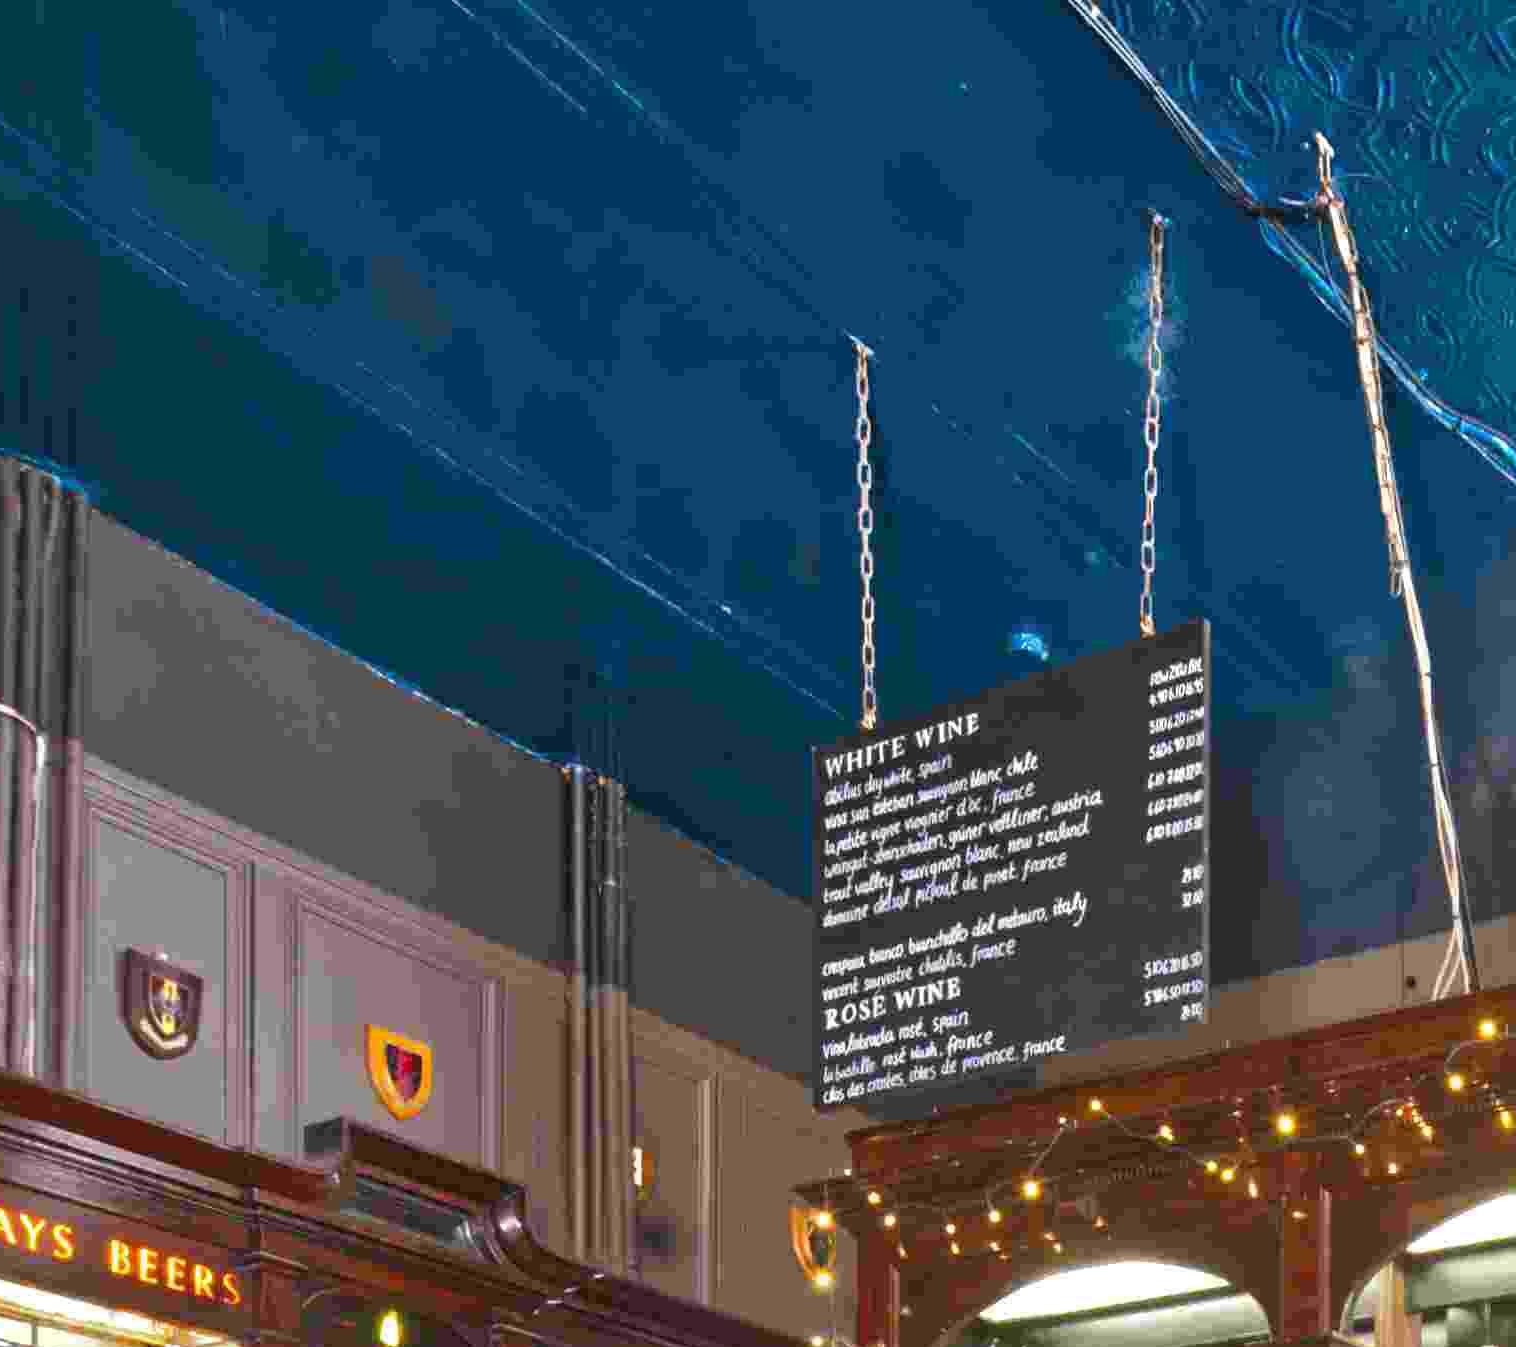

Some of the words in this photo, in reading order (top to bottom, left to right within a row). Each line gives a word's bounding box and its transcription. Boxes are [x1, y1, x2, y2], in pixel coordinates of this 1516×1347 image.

[825, 735, 906, 779] WHITE
[915, 712, 980, 749] WINE
[893, 976, 962, 1012] WINE
[1022, 1034, 1068, 1064] france
[108, 1238, 244, 1305] BEERS
